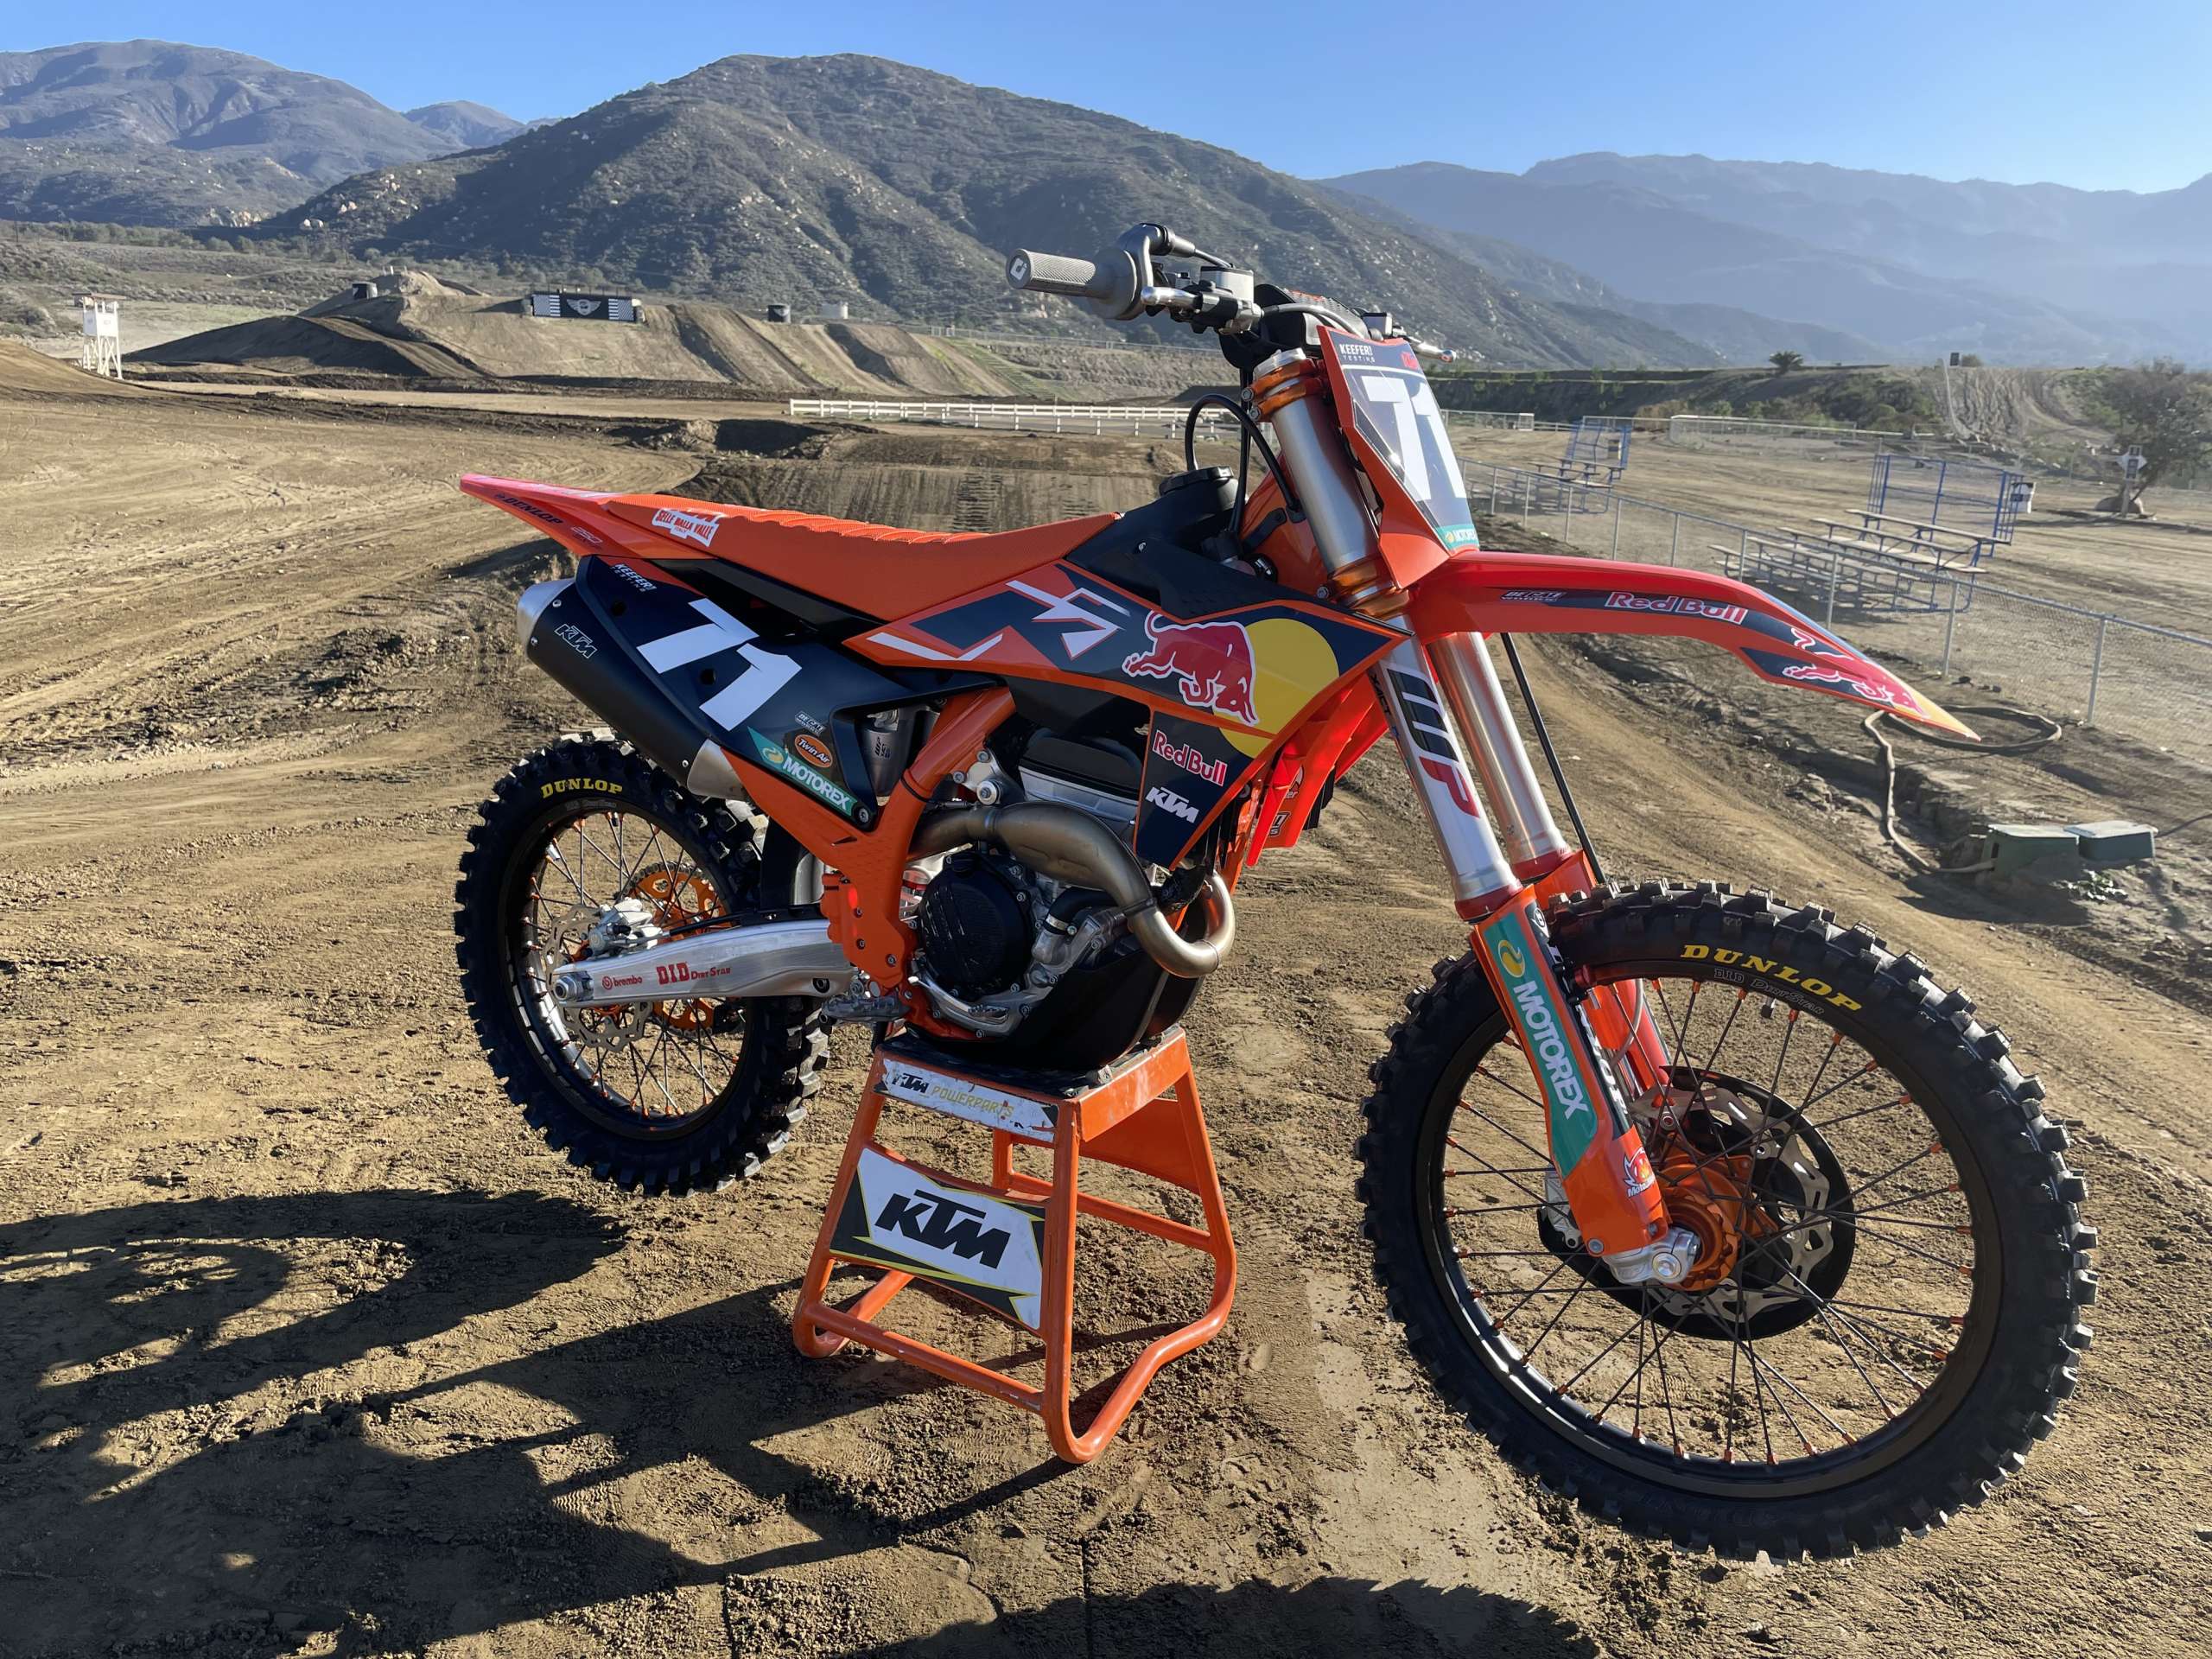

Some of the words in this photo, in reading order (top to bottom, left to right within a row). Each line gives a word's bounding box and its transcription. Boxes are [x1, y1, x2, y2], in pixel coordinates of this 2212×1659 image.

[1361, 375, 1467, 501] 71
[503, 498, 563, 524] DUNLOP
[1605, 592, 1677, 612] Red
[1675, 598, 1748, 625] Bull
[554, 624, 598, 658] KTM
[637, 597, 802, 731] 71
[798, 738, 817, 757] Twin
[817, 753, 830, 764] Air
[1152, 729, 1190, 769] Red
[1186, 748, 1228, 787] Bull
[541, 778, 623, 798] DUNLOP
[782, 757, 850, 810] MOTOREX
[1145, 786, 1200, 823] KTM
[613, 974, 643, 987] brembo
[657, 961, 690, 985] DID
[1681, 944, 1862, 1011] DUNLOP
[1513, 980, 1589, 1121] MOTOREX
[931, 1085, 1014, 1119] POWERPARTS
[874, 1189, 1011, 1269] KTM
